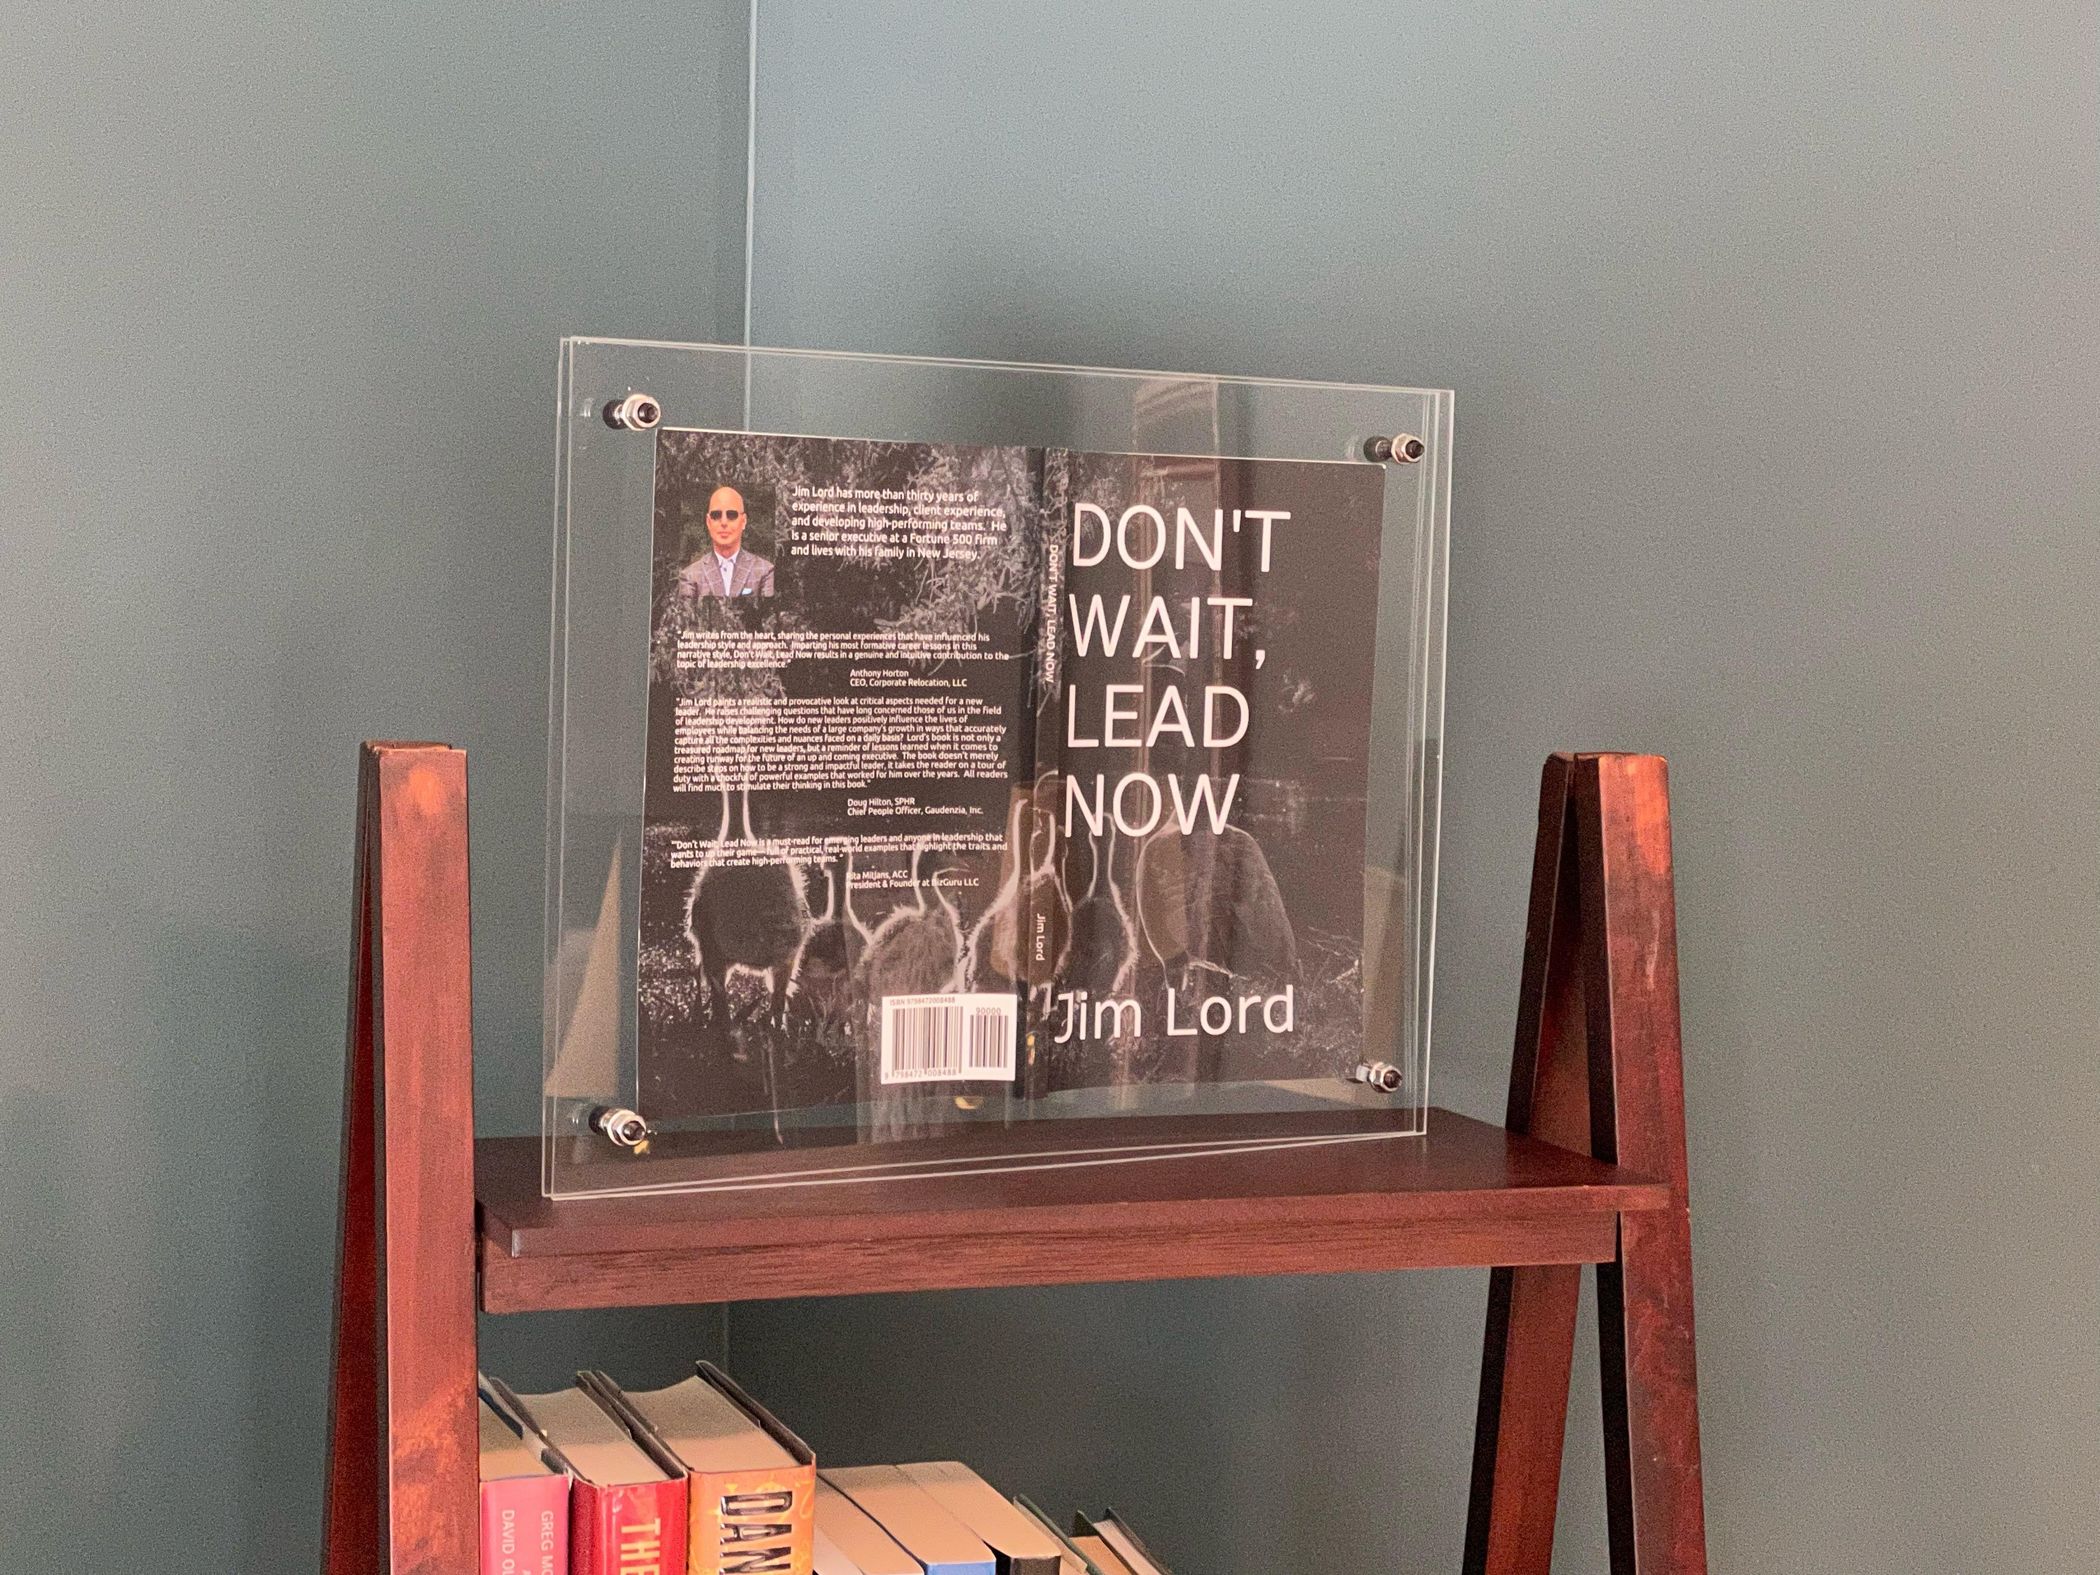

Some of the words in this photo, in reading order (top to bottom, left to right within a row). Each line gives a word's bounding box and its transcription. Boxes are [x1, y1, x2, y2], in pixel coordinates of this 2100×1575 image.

[791, 487, 810, 498] Jim
[812, 487, 835, 498] Lord
[836, 488, 852, 499] has
[854, 490, 880, 499] more
[882, 489, 905, 500] than
[906, 489, 935, 504] thirty
[936, 492, 964, 504] years
[966, 491, 979, 502] of
[791, 501, 845, 516] experience
[847, 502, 856, 513] in
[858, 503, 912, 517] leadership,
[913, 504, 941, 515] client
[943, 505, 1006, 520] experience,
[791, 515, 810, 526] and
[812, 516, 866, 531] developing
[868, 518, 948, 532] high-performing
[950, 519, 986, 530] teams.
[992, 520, 1007, 531] He
[791, 530, 799, 540] is
[801, 532, 807, 541] a
[809, 530, 839, 541] senior
[841, 531, 887, 542] executive
[889, 532, 900, 543] at
[902, 535, 908, 543] a
[910, 533, 950, 544] Fortune
[952, 534, 973, 545] 500
[975, 534, 998, 545] firm
[1073, 502, 1291, 572] DON'T
[791, 544, 810, 555] and
[811, 545, 833, 556] lives
[834, 545, 856, 556] with
[858, 546, 873, 556] his
[874, 546, 904, 560] family
[906, 546, 915, 557] in
[917, 547, 940, 558] New
[943, 547, 980, 562] Jersey.
[1049, 544, 1059, 582] DON'T
[1045, 584, 1057, 617] WAIT,
[778, 632, 804, 642] sharing
[820, 632, 851, 642] personal
[852, 632, 896, 643] experiences
[934, 633, 976, 641] influenced
[978, 633, 990, 641] his
[1046, 620, 1056, 650] LEAD
[1069, 593, 1266, 669] WAIT,
[677, 640, 716, 651] leadership
[860, 641, 896, 650] formative
[677, 650, 711, 659] narrative
[813, 651, 839, 659] results
[854, 651, 884, 661] genuine
[900, 651, 931, 659] intuitive
[933, 651, 982, 660] contribution
[850, 669, 881, 679] Anthony
[882, 669, 909, 677] Horton
[1045, 653, 1055, 683] NOW
[850, 678, 868, 688] CEO,
[869, 678, 907, 688] Corporate
[908, 678, 951, 688] Relocation,
[952, 678, 967, 687] LLC
[788, 697, 832, 708] provocative
[859, 697, 884, 705] critical
[885, 697, 913, 707] aspects
[914, 697, 944, 705] needed
[783, 706, 819, 717] questions
[873, 706, 912, 714] concerned
[914, 706, 935, 714] those
[967, 706, 981, 714] the
[982, 706, 1002, 714] field
[1067, 684, 1250, 748] LEAD
[685, 716, 724, 727] leadership
[852, 715, 888, 726] positively
[888, 715, 923, 724] influence
[674, 726, 716, 736] employees
[888, 724, 915, 735] growth
[946, 724, 962, 733] that
[964, 724, 1007, 734] accurately
[674, 736, 706, 746] capture
[730, 735, 776, 745] complexities
[931, 733, 951, 742] book
[976, 733, 995, 744] only
[900, 743, 929, 751] learned
[930, 742, 951, 751] when
[988, 742, 998, 751] to
[674, 754, 706, 765] creating
[917, 752, 937, 760] book
[938, 751, 969, 760] doesn't
[970, 751, 999, 762] merely
[673, 764, 706, 773] describe
[784, 762, 809, 772] strong
[894, 761, 915, 769] takes
[931, 761, 956, 769] reader
[977, 761, 995, 769] tour
[996, 760, 1006, 769] of
[673, 774, 691, 784] duty
[759, 772, 793, 782] powerful
[794, 771, 829, 782] examples
[847, 771, 875, 779] worked
[888, 770, 903, 779] him
[937, 772, 960, 781] years.
[963, 770, 975, 779] All
[976, 770, 1008, 778] readers
[791, 781, 822, 791] thinking
[832, 780, 846, 788] this
[847, 799, 868, 809] Doug
[868, 798, 893, 808] Hilton,
[894, 798, 916, 806] SPHR
[1064, 772, 1240, 838] NOW
[847, 808, 867, 816] Chief
[868, 808, 894, 818] People
[895, 807, 924, 816] Officer,
[924, 807, 968, 816] Gaudenzia,
[969, 806, 984, 814] Inc.
[860, 835, 887, 843] leaders
[888, 835, 902, 843] and
[942, 834, 984, 844] leadership
[985, 833, 1003, 842] that
[670, 850, 694, 859] wants
[864, 843, 899, 854] examples
[968, 842, 990, 851] traits
[992, 842, 1008, 850] and
[726, 857, 750, 866] create
[751, 856, 812, 867] high-performing
[892, 870, 908, 879] ACC
[921, 879, 930, 887] at
[964, 878, 979, 886] LLC
[1036, 913, 1046, 933] Jim
[1035, 935, 1046, 961] Lord
[975, 1007, 1002, 1015] 90000
[1054, 990, 1142, 1044] Jim
[1167, 984, 1294, 1036] Lord
[502, 1509, 515, 1554] DAVID
[541, 1511, 553, 1551] GREG
[720, 1491, 792, 1574] DAN
